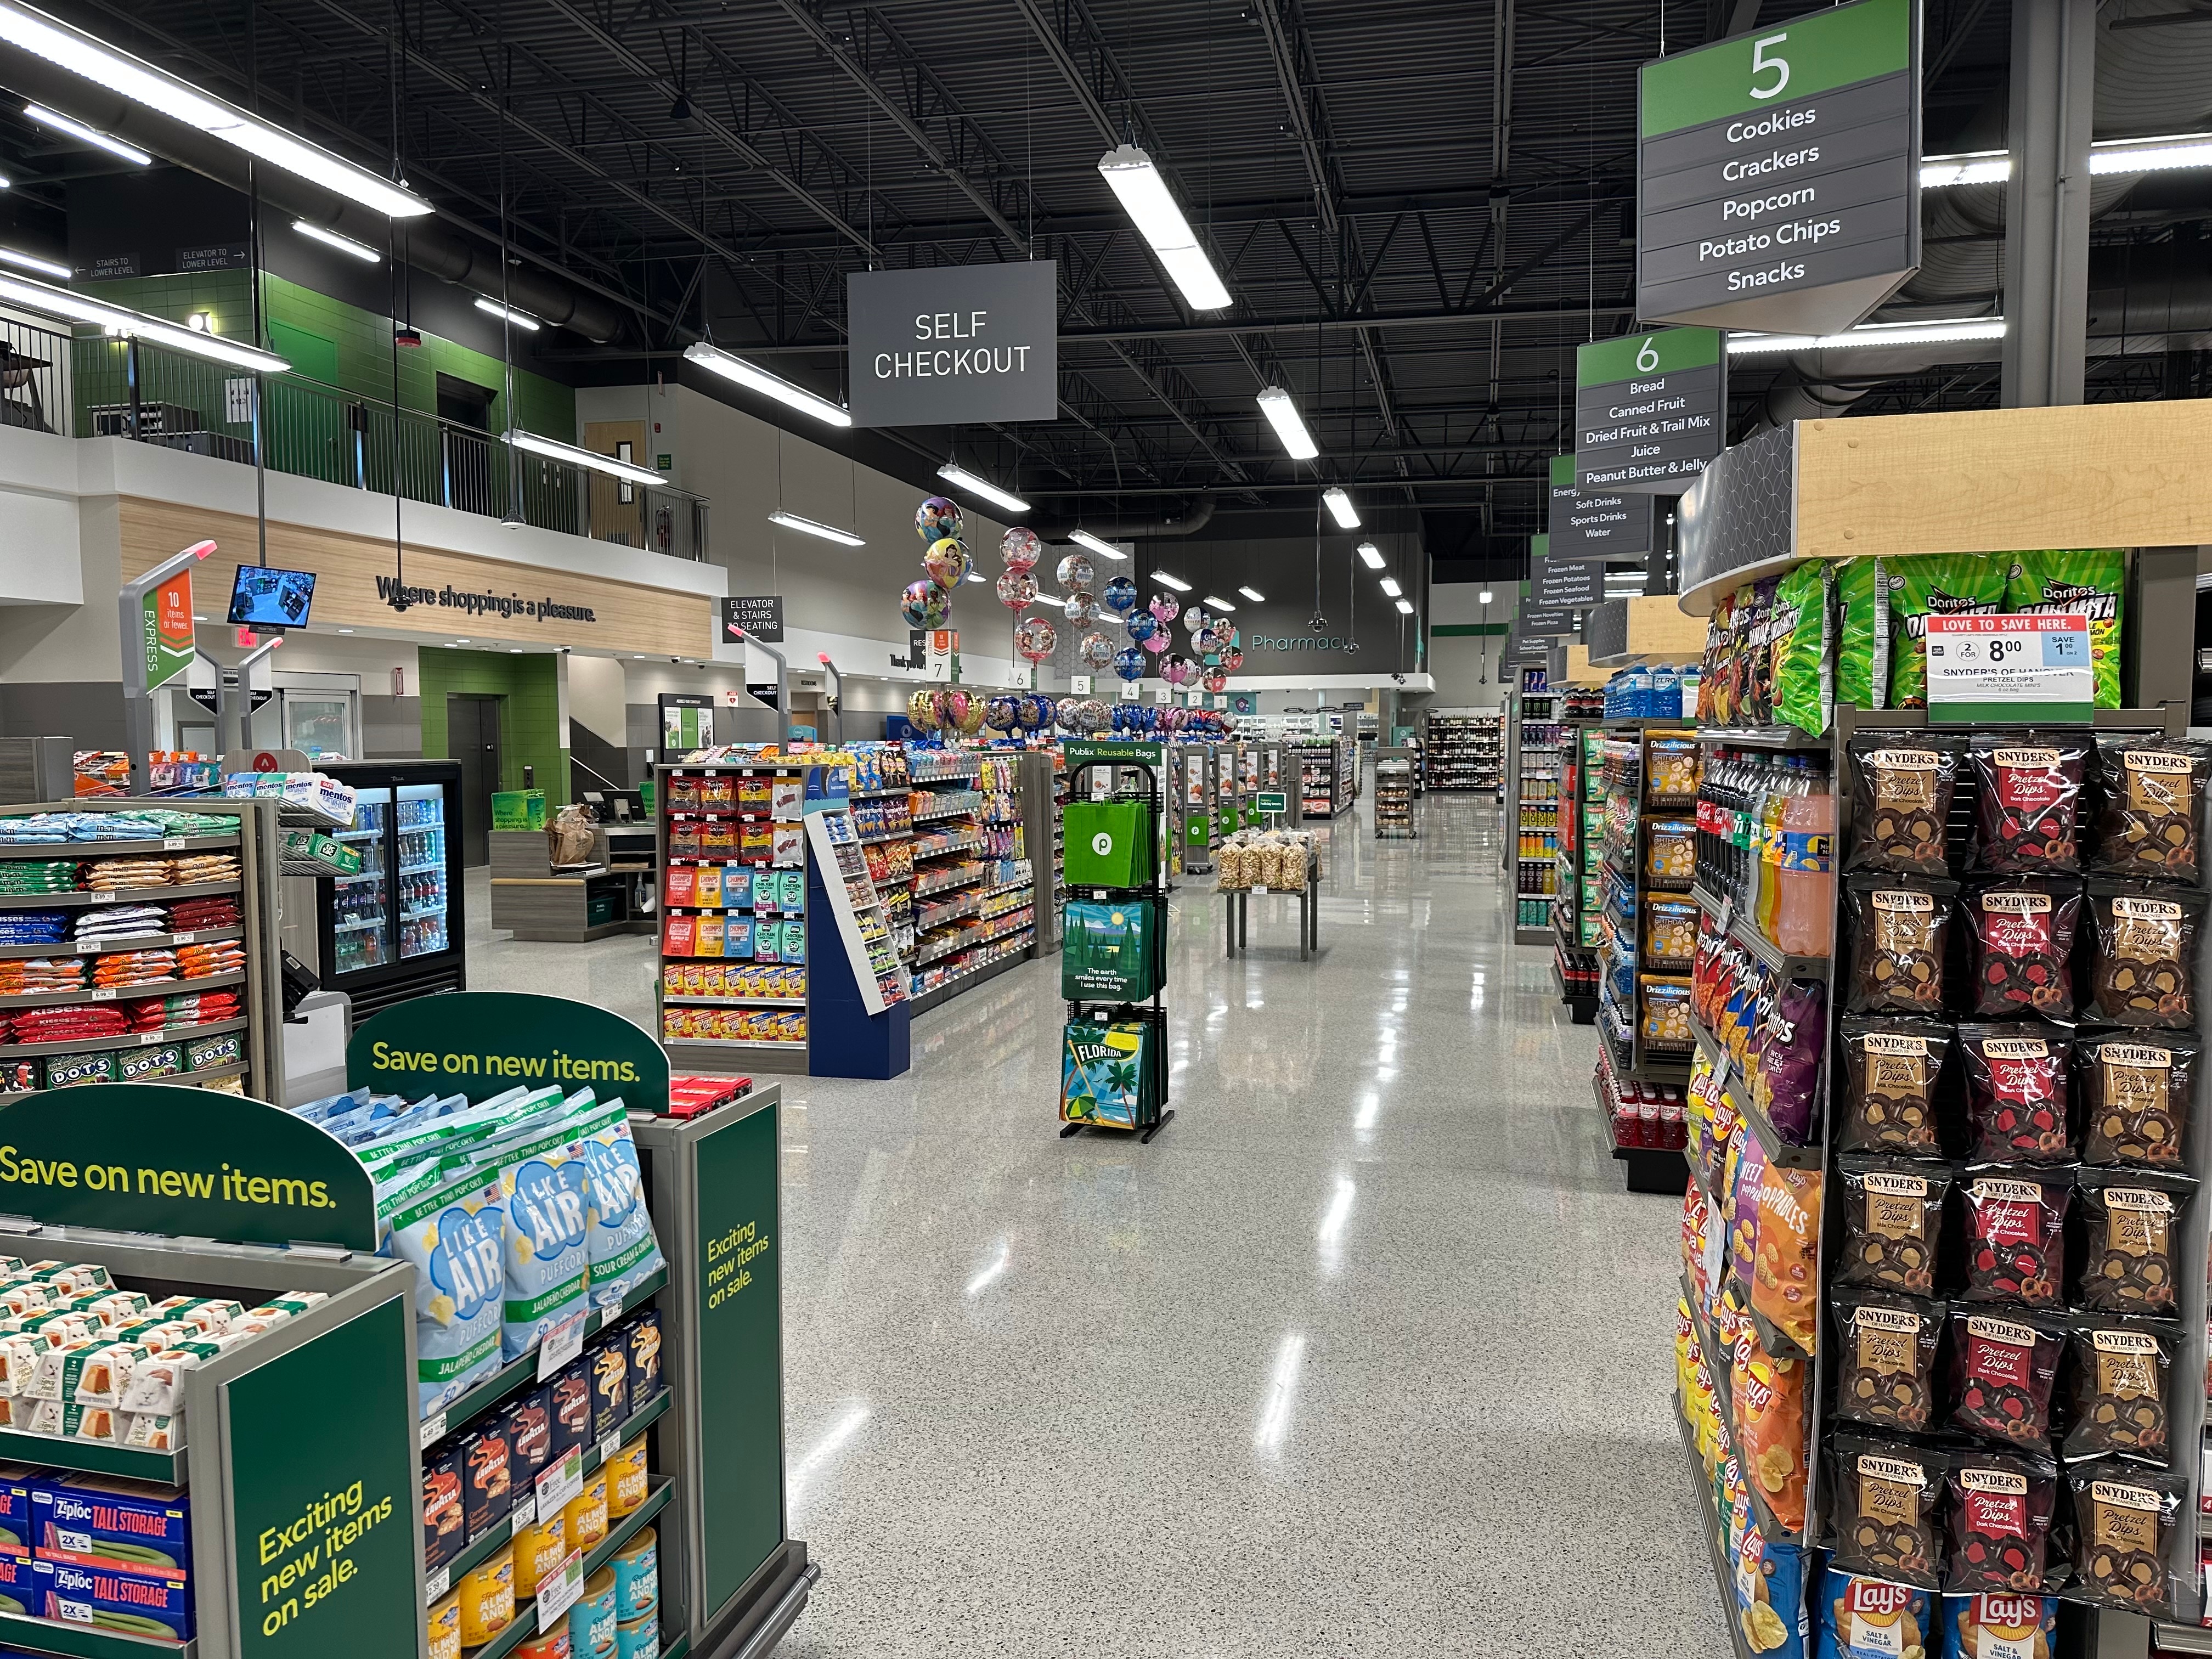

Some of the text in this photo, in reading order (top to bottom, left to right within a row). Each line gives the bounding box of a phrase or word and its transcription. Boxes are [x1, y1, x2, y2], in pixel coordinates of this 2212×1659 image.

[1749, 33, 1790, 99] 5
[1726, 109, 1816, 143] Cookies
[1723, 146, 1819, 181] Crackers
[1723, 187, 1815, 221] Popcorn
[1700, 218, 1841, 261] Potato Chips
[182, 257, 228, 268] LOWER LEVEL
[183, 250, 217, 259] ELEVATOR
[97, 259, 118, 267] STAIRS
[91, 267, 134, 277] LOWER LEVEL
[1727, 262, 1804, 291] Snacks
[916, 311, 987, 340] SELF
[875, 346, 1030, 378] CHECKOUT
[1636, 337, 1659, 372] 6
[1630, 379, 1664, 394] Bread
[1609, 397, 1685, 419] Canned Fruit
[1586, 416, 1711, 444] Dried Fruit & Trail Mix
[1631, 444, 1660, 458] Juice
[1586, 459, 1707, 484] Peanut Butter & Jelly
[1553, 488, 1580, 497] Energ
[1576, 498, 1622, 510] Soft Drinks
[1571, 512, 1627, 527] Sports Drinks
[1585, 529, 1611, 538] Water
[168, 592, 179, 608] 10
[1559, 595, 1593, 605] Vegetables
[2042, 585, 2096, 601] Doritos
[439, 585, 511, 618] shopping
[512, 592, 524, 614] is
[527, 601, 536, 616] a
[538, 597, 596, 622] pleasure.
[731, 600, 774, 608] ELEVATOR
[166, 609, 184, 619] items
[742, 611, 771, 619] STAIRS
[163, 620, 170, 629] or
[741, 622, 777, 630] SEATING
[1943, 619, 2072, 631] LOVE TO SAVE HERE.
[144, 610, 158, 672] EXPRESS
[935, 664, 942, 677] 7
[1017, 673, 1024, 685] 6
[1078, 681, 1084, 691] 5
[1127, 687, 1133, 696] 4
[1161, 692, 1166, 701] 3
[1650, 741, 1696, 749] Drizzilicious
[1069, 748, 1156, 759] Publix Reusable Bags
[320, 788, 353, 804] mentos
[322, 849, 334, 857] tac
[1096, 975, 1113, 984] every
[31, 1005, 82, 1017] KISSES
[1077, 1045, 1122, 1062] FLORIDA
[373, 1041, 641, 1083] Save on new items.
[52, 1058, 110, 1085] DOTS
[0, 1146, 336, 1209] Save on new items.
[442, 1217, 488, 1258] LIKE
[708, 1221, 755, 1262] Exciting
[709, 1235, 768, 1287] new items
[449, 1238, 501, 1312] AIR
[709, 1269, 752, 1309] on sale.
[1972, 1319, 2031, 1340] SNYDER'S
[1977, 1344, 2022, 1361] Pretzel
[476, 1454, 505, 1481] LAVAZZA
[57, 1500, 167, 1537] Ziploc TALL STORAGE
[259, 1481, 363, 1566] Exciting
[62, 1536, 75, 1545] 2X
[261, 1493, 393, 1604] new items
[262, 1557, 359, 1636] on sale.
[1854, 1582, 1906, 1615] Lay's
[1862, 1636, 1892, 1646] VINEGAR
[1866, 1630, 1882, 1639] SALT
